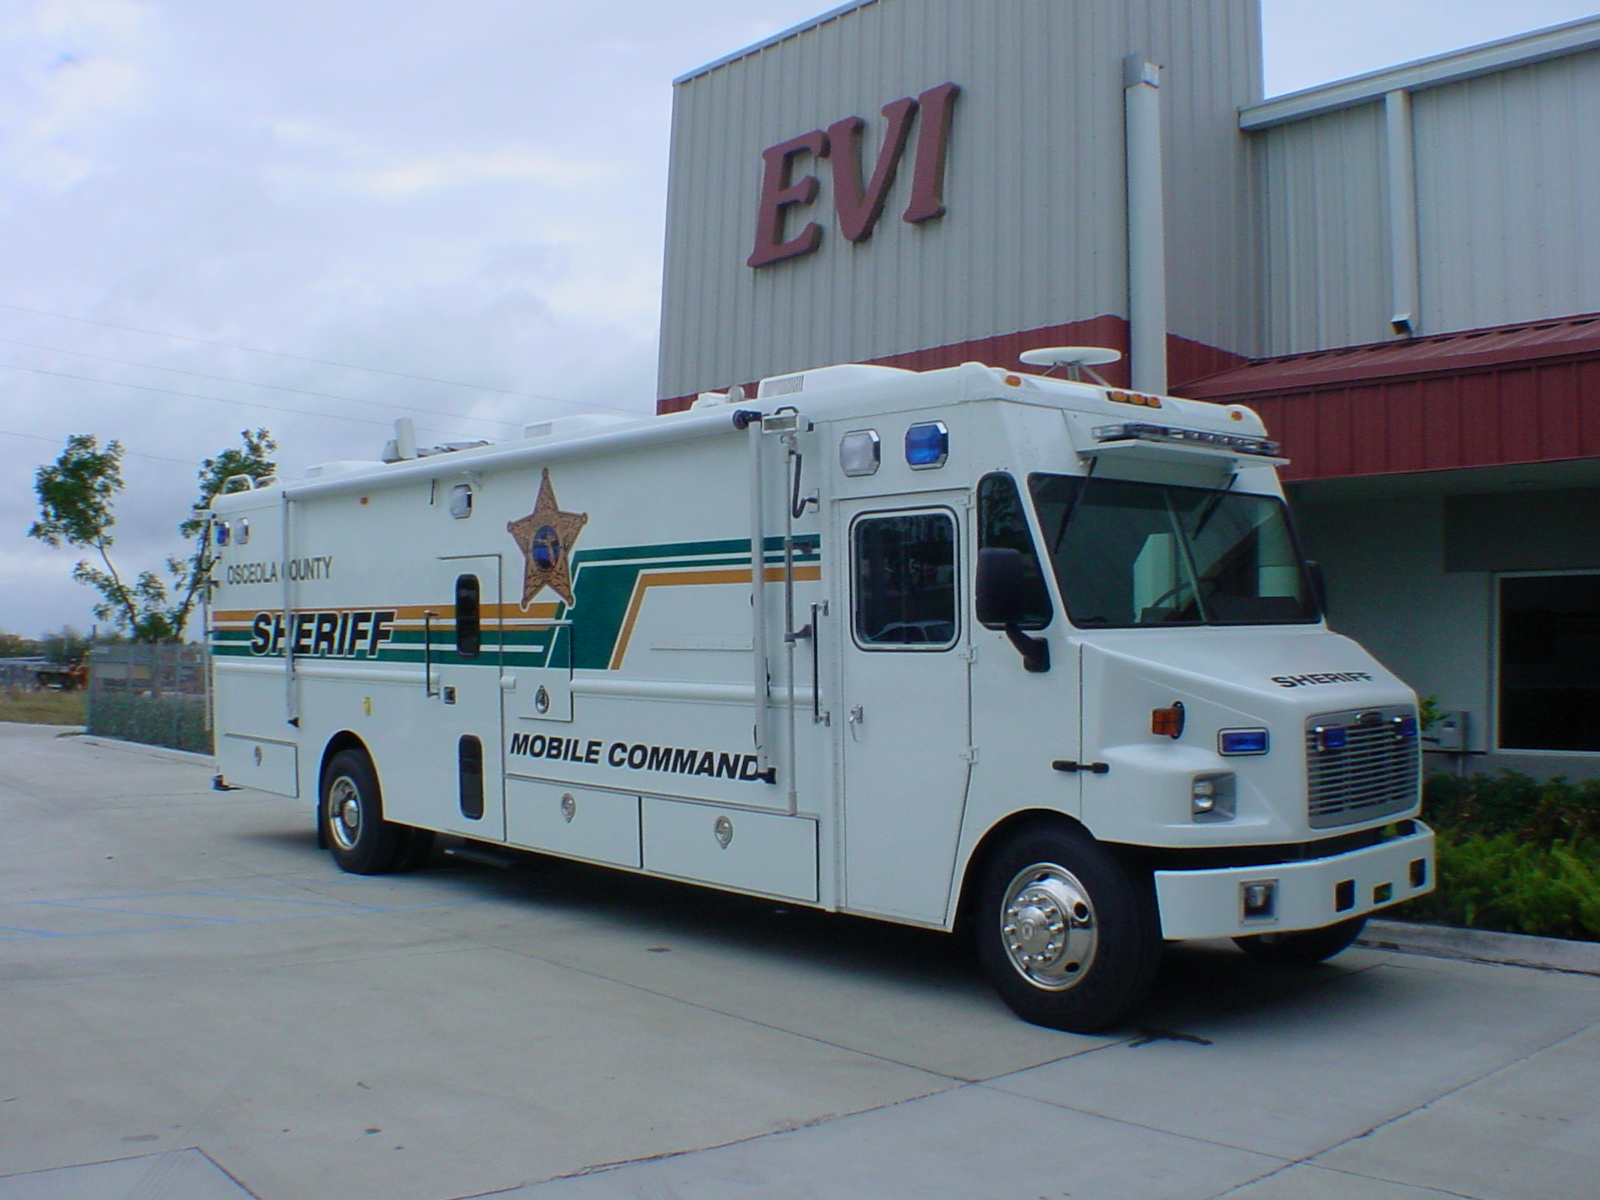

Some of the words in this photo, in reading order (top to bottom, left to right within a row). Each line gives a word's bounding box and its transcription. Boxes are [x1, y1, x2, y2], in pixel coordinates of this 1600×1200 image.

[746, 81, 962, 267] EVI
[227, 561, 278, 585] OSCEOLA
[251, 610, 397, 657] SHERIFF
[1270, 672, 1373, 688] SHERIFF
[510, 733, 602, 764] MOBILE
[607, 742, 759, 782] COMMAND
